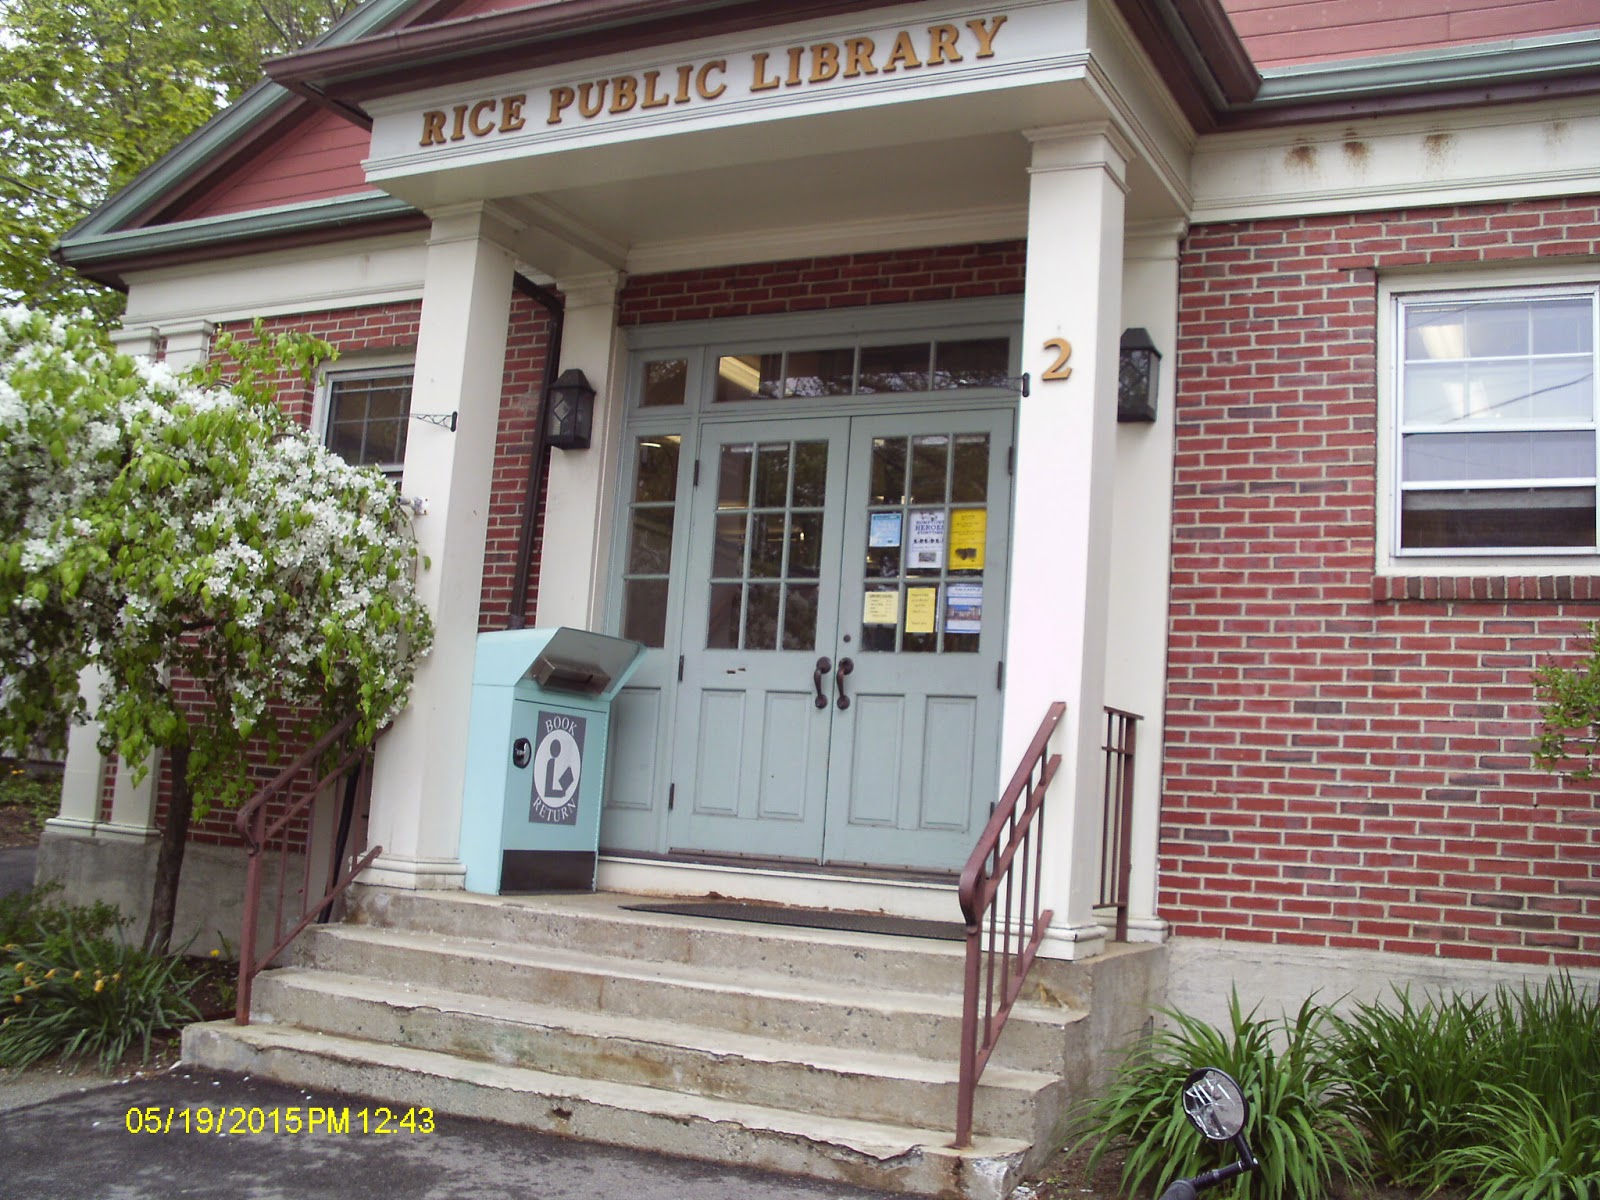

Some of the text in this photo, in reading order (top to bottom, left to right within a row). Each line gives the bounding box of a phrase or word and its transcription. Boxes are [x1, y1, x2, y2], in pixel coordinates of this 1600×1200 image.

[419, 15, 1007, 146] RICE PUBLIC LIBRARY
[1042, 338, 1072, 381] 2
[545, 716, 577, 736] BOOK
[533, 797, 576, 823] RETURN
